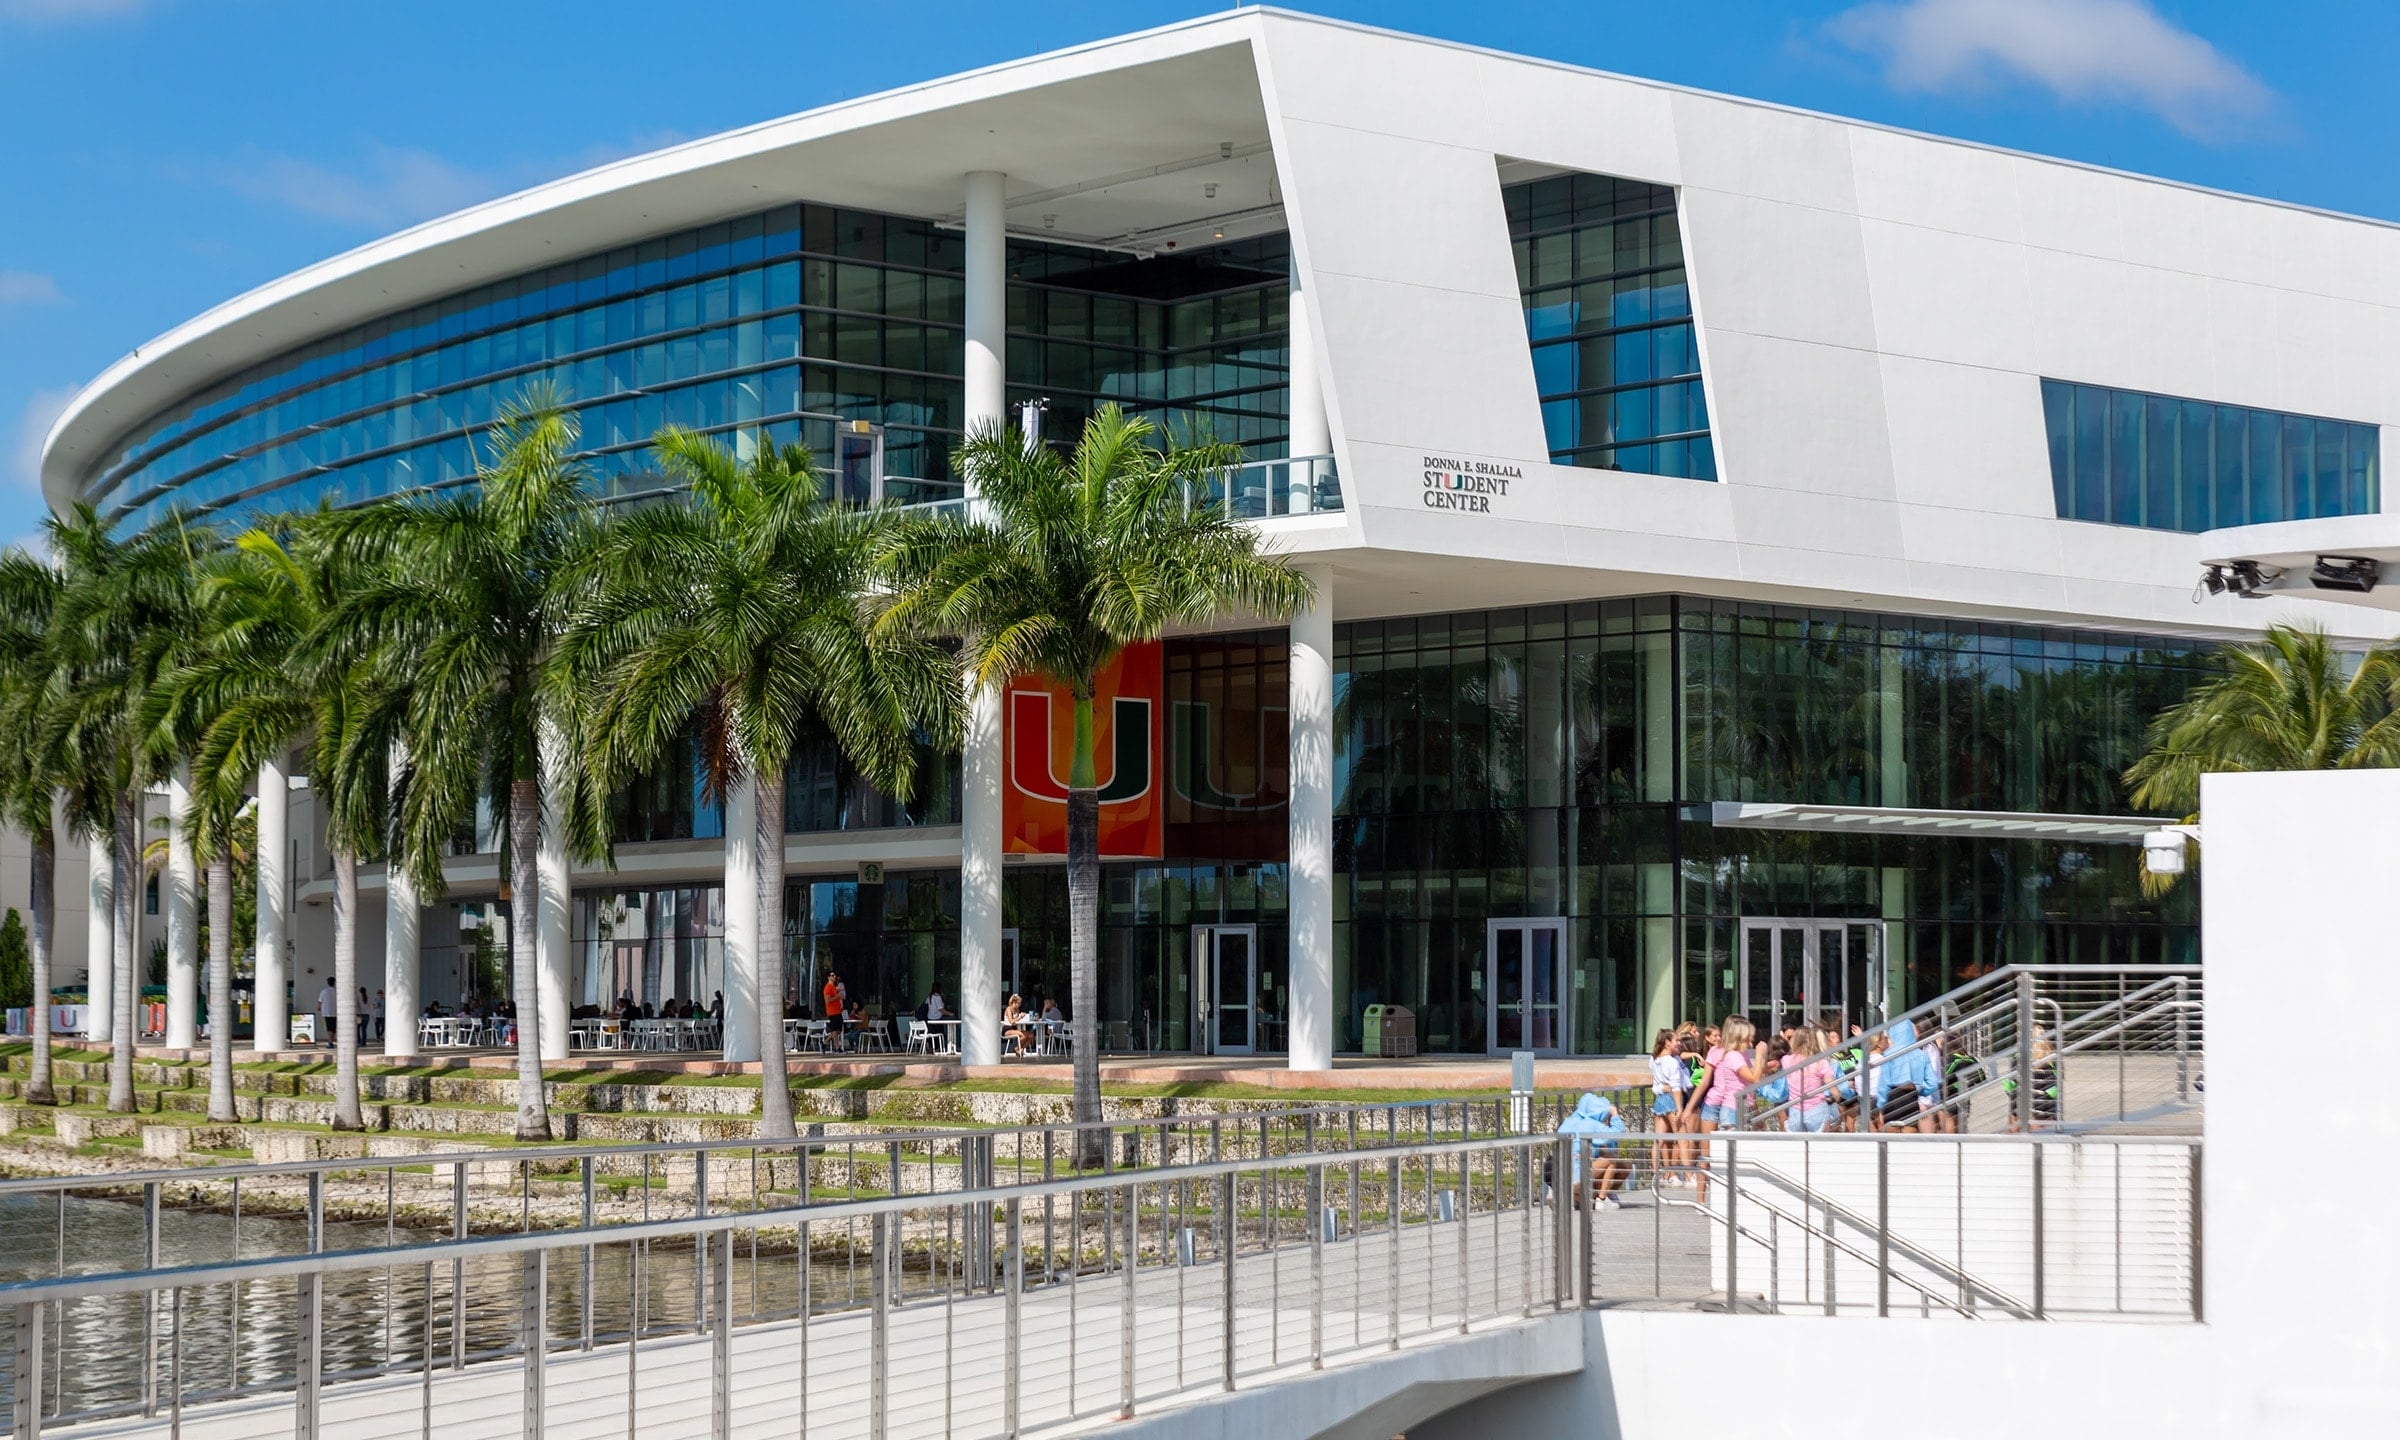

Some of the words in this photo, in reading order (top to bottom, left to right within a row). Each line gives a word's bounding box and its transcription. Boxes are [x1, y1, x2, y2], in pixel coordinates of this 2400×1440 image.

[1424, 457, 1461, 471] DONNA
[1464, 461, 1473, 472] E.
[1475, 463, 1522, 478] SHALALA
[1424, 471, 1509, 496] STUDENT
[1424, 490, 1490, 513] CENTER
[1011, 690, 1151, 804] U
[60, 1010, 77, 1028] U
